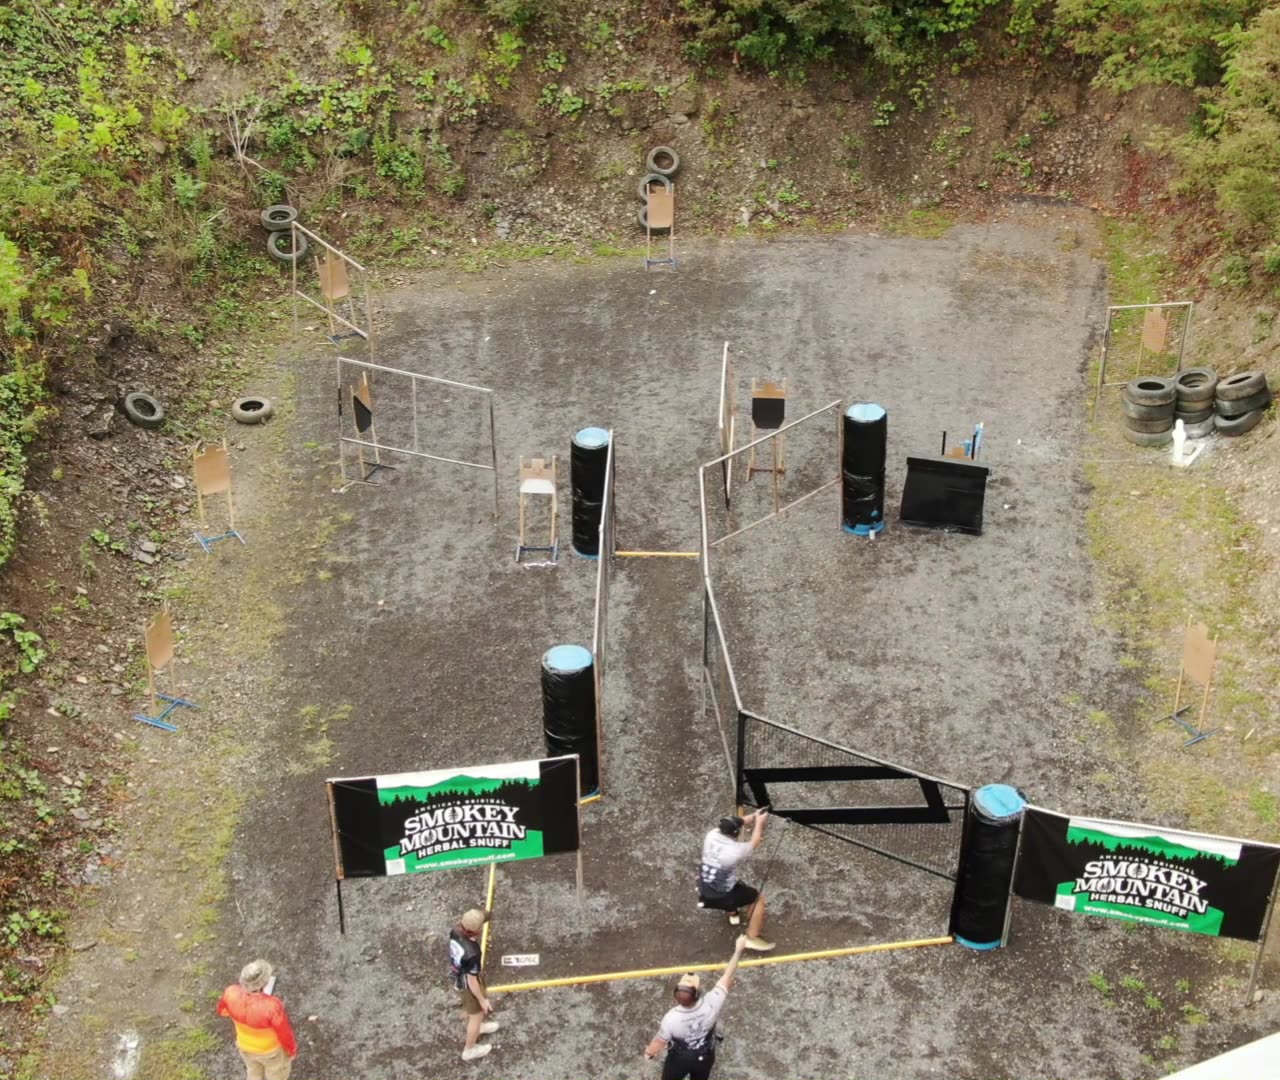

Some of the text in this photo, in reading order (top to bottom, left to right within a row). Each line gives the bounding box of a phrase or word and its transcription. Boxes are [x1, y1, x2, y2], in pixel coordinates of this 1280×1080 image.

[404, 804, 520, 836] SMOKEY
[400, 821, 526, 855] MOUNTAIN
[418, 838, 509, 858] HERBAL SNUFF
[1083, 860, 1207, 895] SMOKEY
[1073, 878, 1208, 913] MOUNTAIN
[1090, 893, 1188, 917] HERBAL SNUFF
